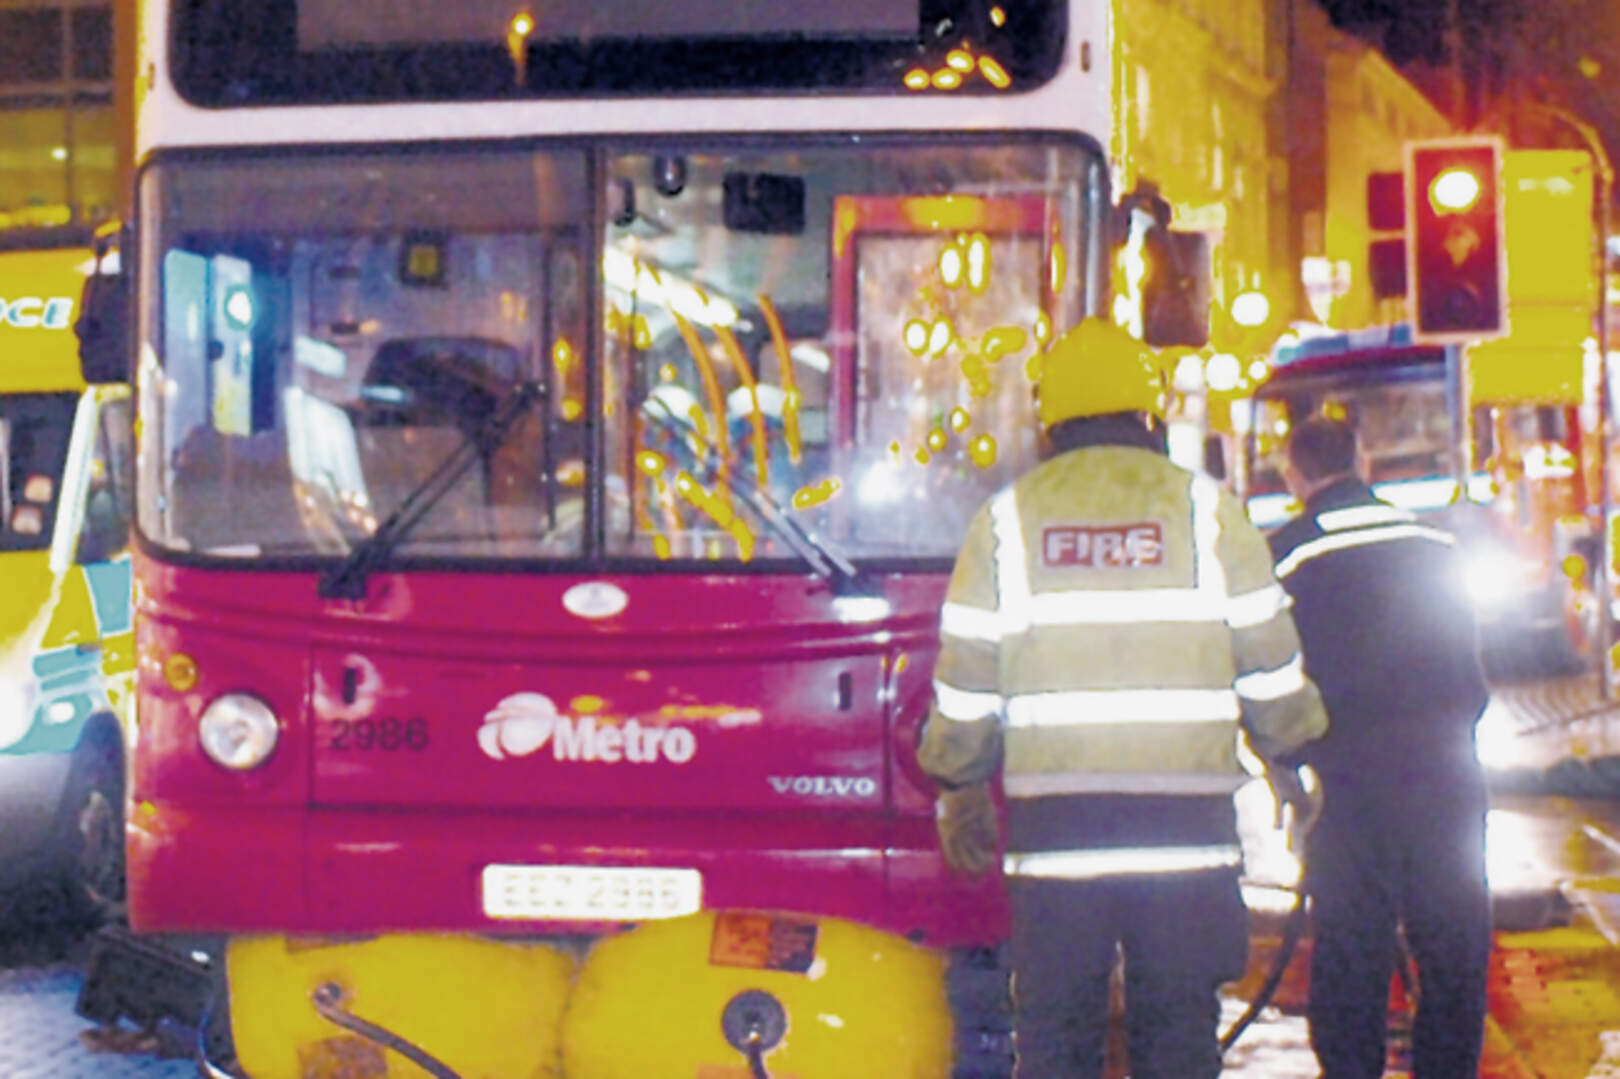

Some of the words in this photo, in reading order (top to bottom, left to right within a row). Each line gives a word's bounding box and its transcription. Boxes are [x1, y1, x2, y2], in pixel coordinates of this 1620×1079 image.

[1045, 529, 1161, 568] FIRE
[330, 717, 429, 750] 2986
[553, 714, 696, 763] Metro
[767, 775, 876, 796] VOLVO
